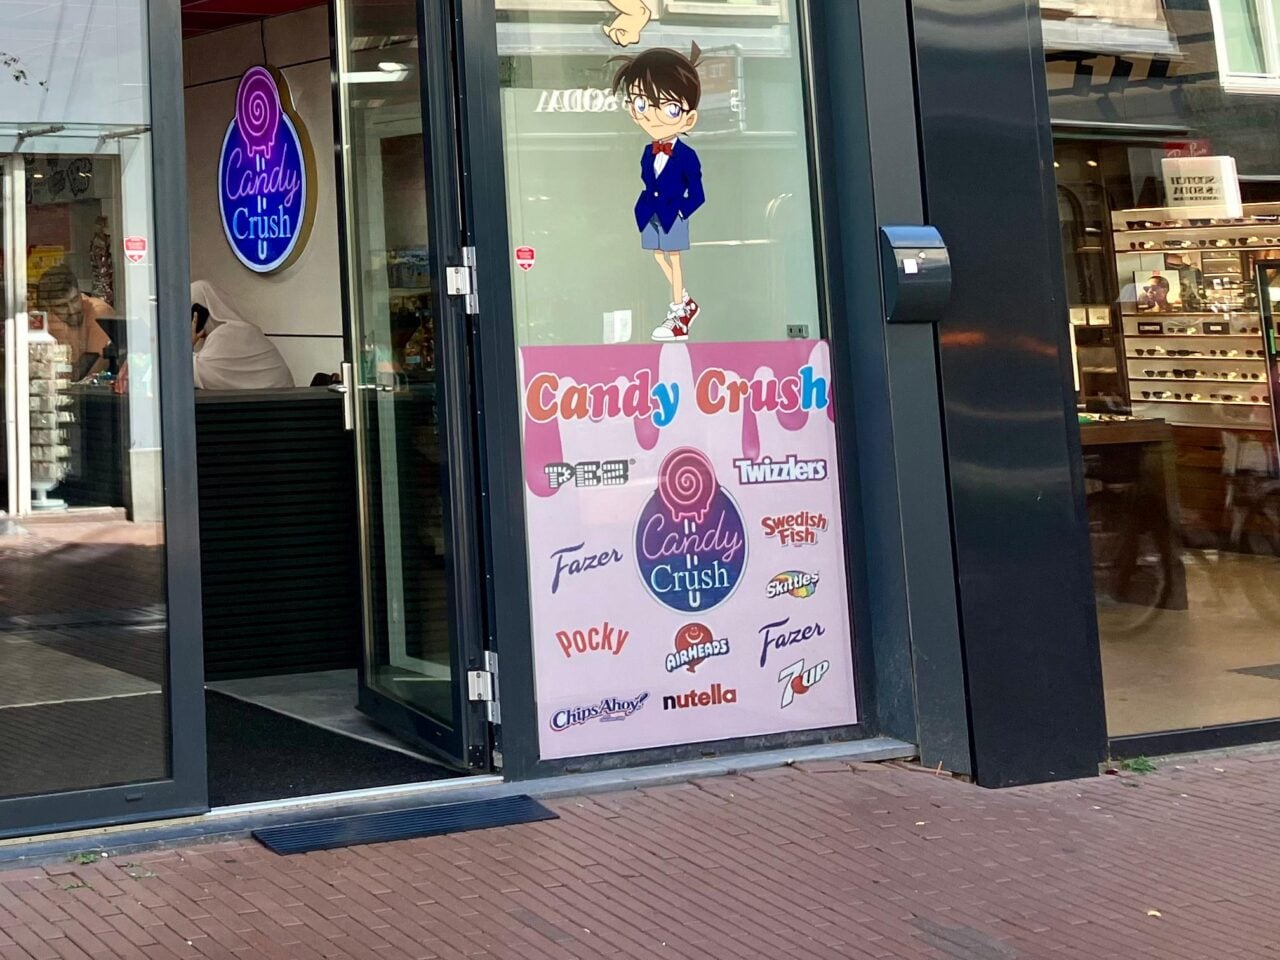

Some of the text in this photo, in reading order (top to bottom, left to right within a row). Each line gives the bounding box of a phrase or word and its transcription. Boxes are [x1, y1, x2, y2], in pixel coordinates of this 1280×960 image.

[225, 143, 301, 208] Candy
[232, 204, 292, 240] Crush
[524, 365, 830, 428] Candy Crush
[733, 454, 828, 485] Twizzlers
[642, 510, 743, 562] Candy
[761, 511, 829, 537] Swedish
[777, 526, 819, 546] Fish
[550, 541, 624, 595] Fazer
[650, 560, 731, 593] Crush
[765, 571, 820, 599] Skittles
[665, 638, 730, 673] AIRHEADS
[757, 616, 826, 669] Fazer
[662, 683, 737, 711] nutella
